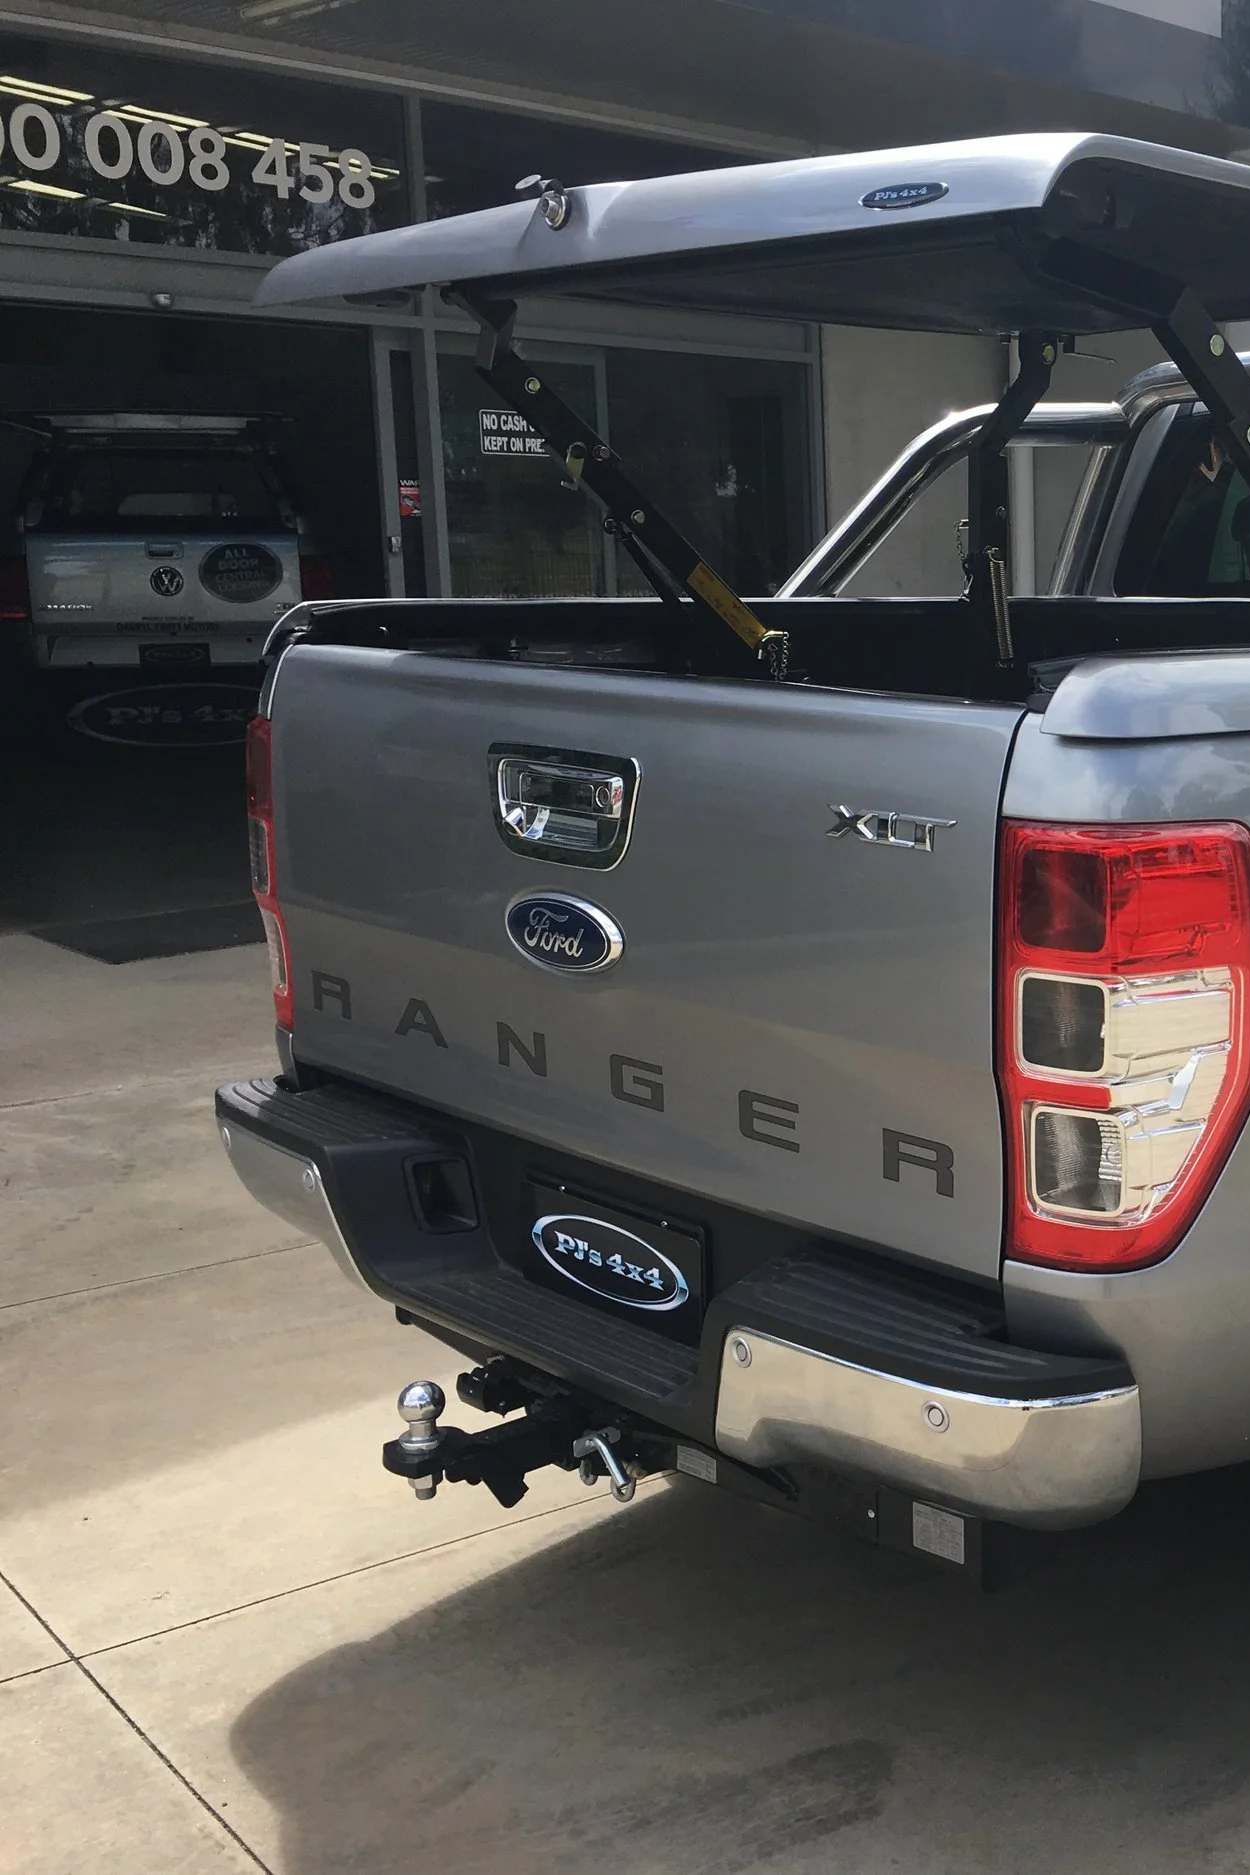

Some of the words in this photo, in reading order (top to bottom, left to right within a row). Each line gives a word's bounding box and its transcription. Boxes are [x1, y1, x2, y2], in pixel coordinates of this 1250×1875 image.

[0, 103, 61, 171] 0
[84, 112, 231, 191] 008
[251, 137, 376, 209] 458
[874, 191, 898, 201] PJ's
[899, 186, 928, 198] 4x4
[482, 413, 499, 430] NO
[500, 414, 527, 432] CASH
[483, 436, 508, 452] KEPT
[510, 437, 523, 453] ON
[826, 804, 958, 852] XLT
[524, 907, 584, 957] Ford
[312, 970, 955, 1198] RANGER
[554, 1230, 602, 1267] PJ's
[606, 1253, 665, 1291] 4x4
